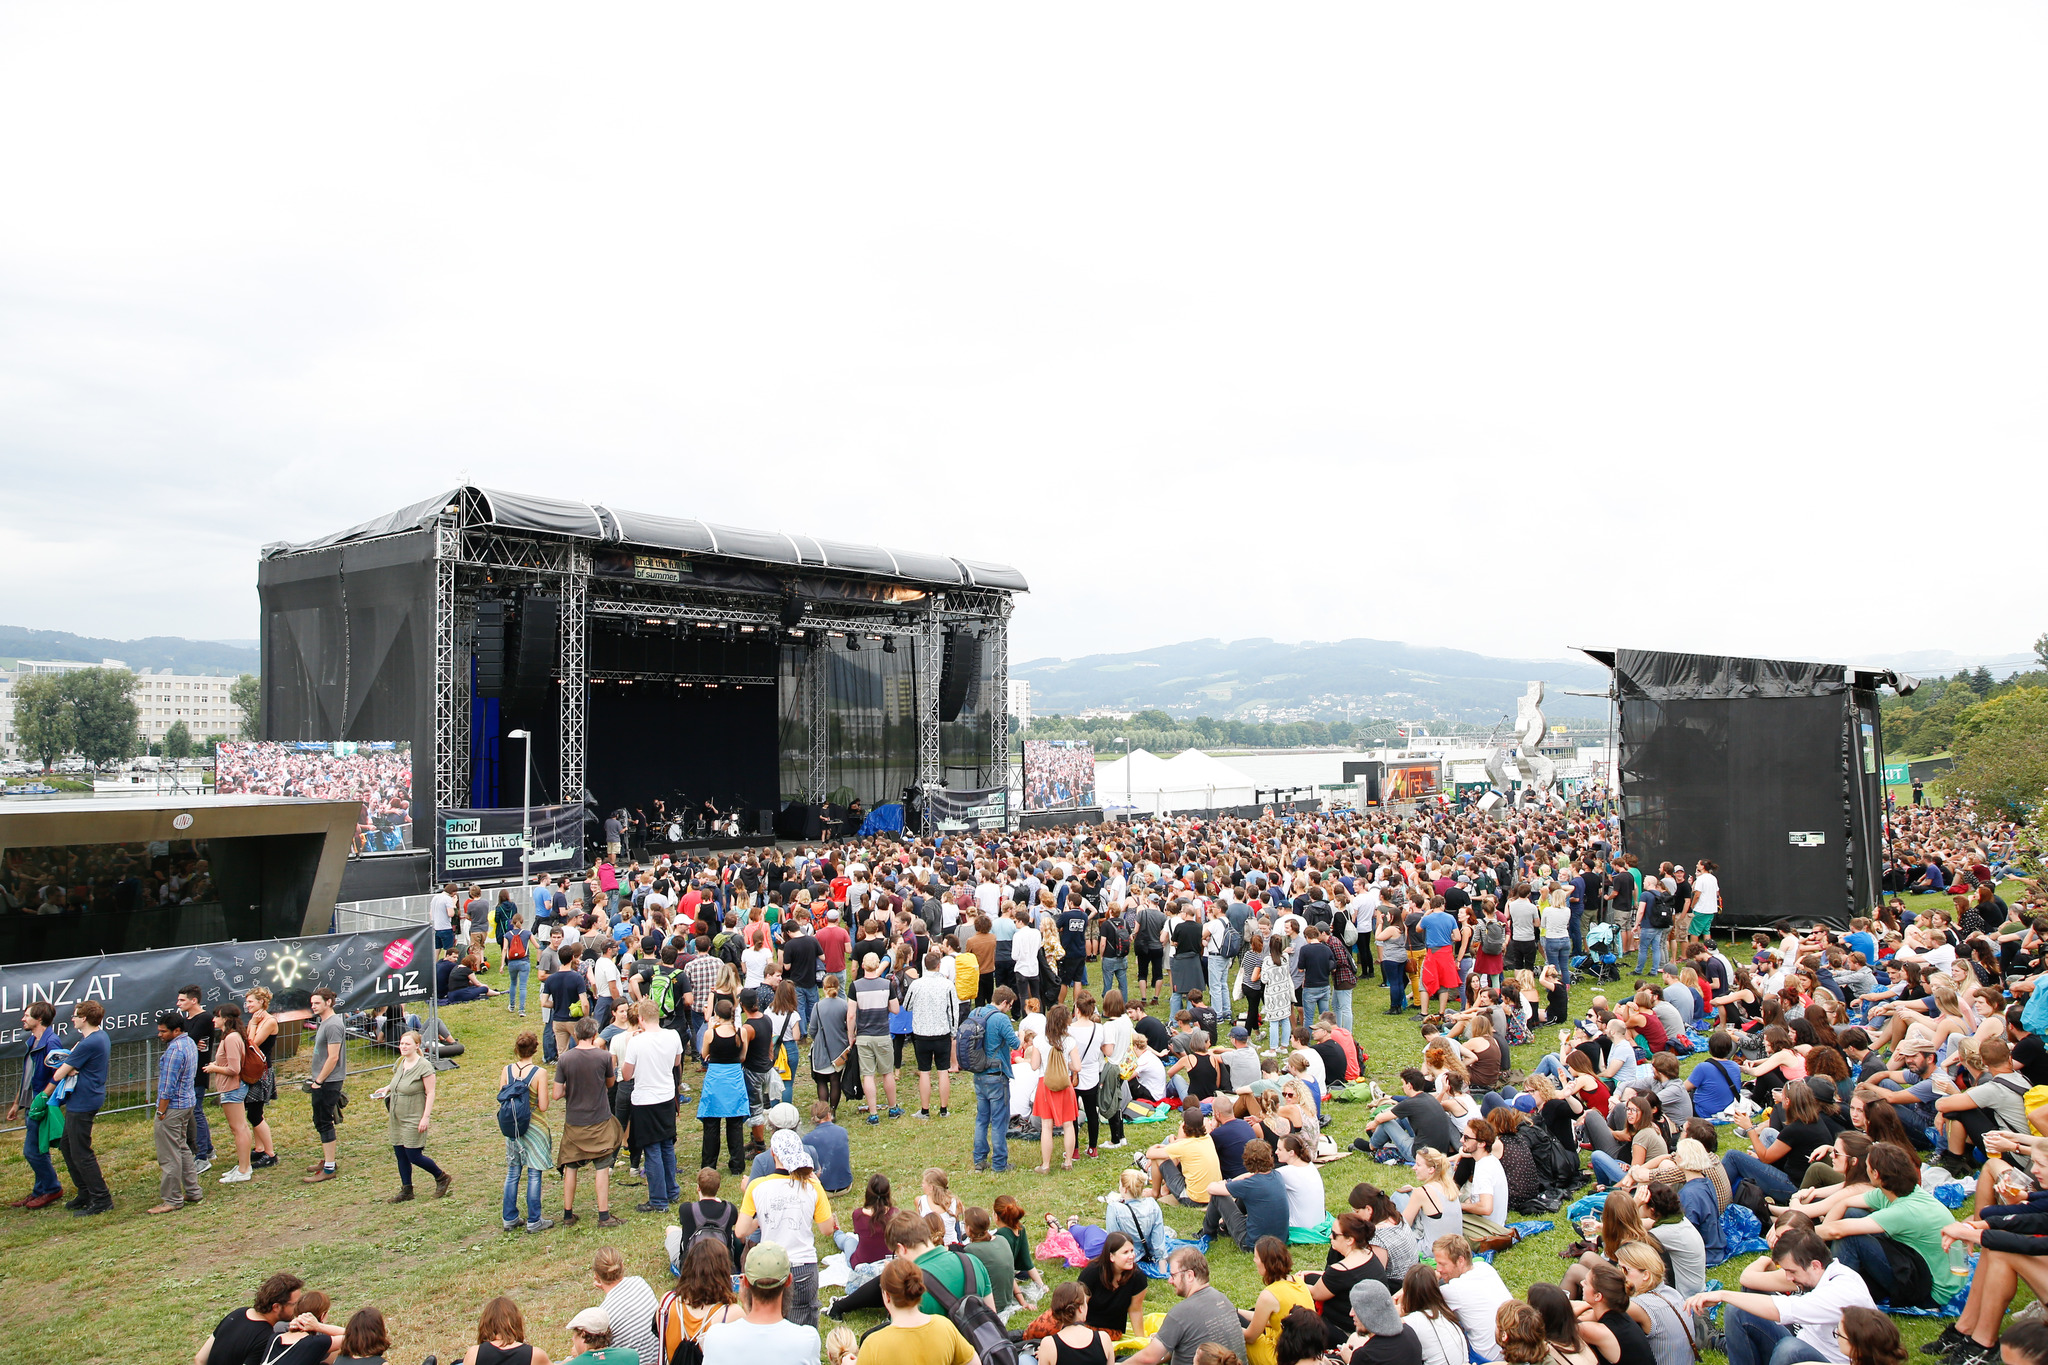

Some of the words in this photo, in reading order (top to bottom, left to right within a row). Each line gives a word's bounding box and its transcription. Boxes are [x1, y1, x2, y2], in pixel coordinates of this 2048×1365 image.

[655, 559, 667, 568] the
[637, 569, 644, 577] of
[1880, 768, 1903, 780] XIT
[969, 808, 979, 816] the
[997, 806, 1004, 814] of
[448, 821, 477, 833] ahoi!
[448, 839, 468, 850] the
[471, 838, 488, 849] full
[492, 837, 506, 848] hit
[509, 836, 521, 847] of
[448, 856, 500, 868] summer.
[0, 1027, 22, 1044] EE
